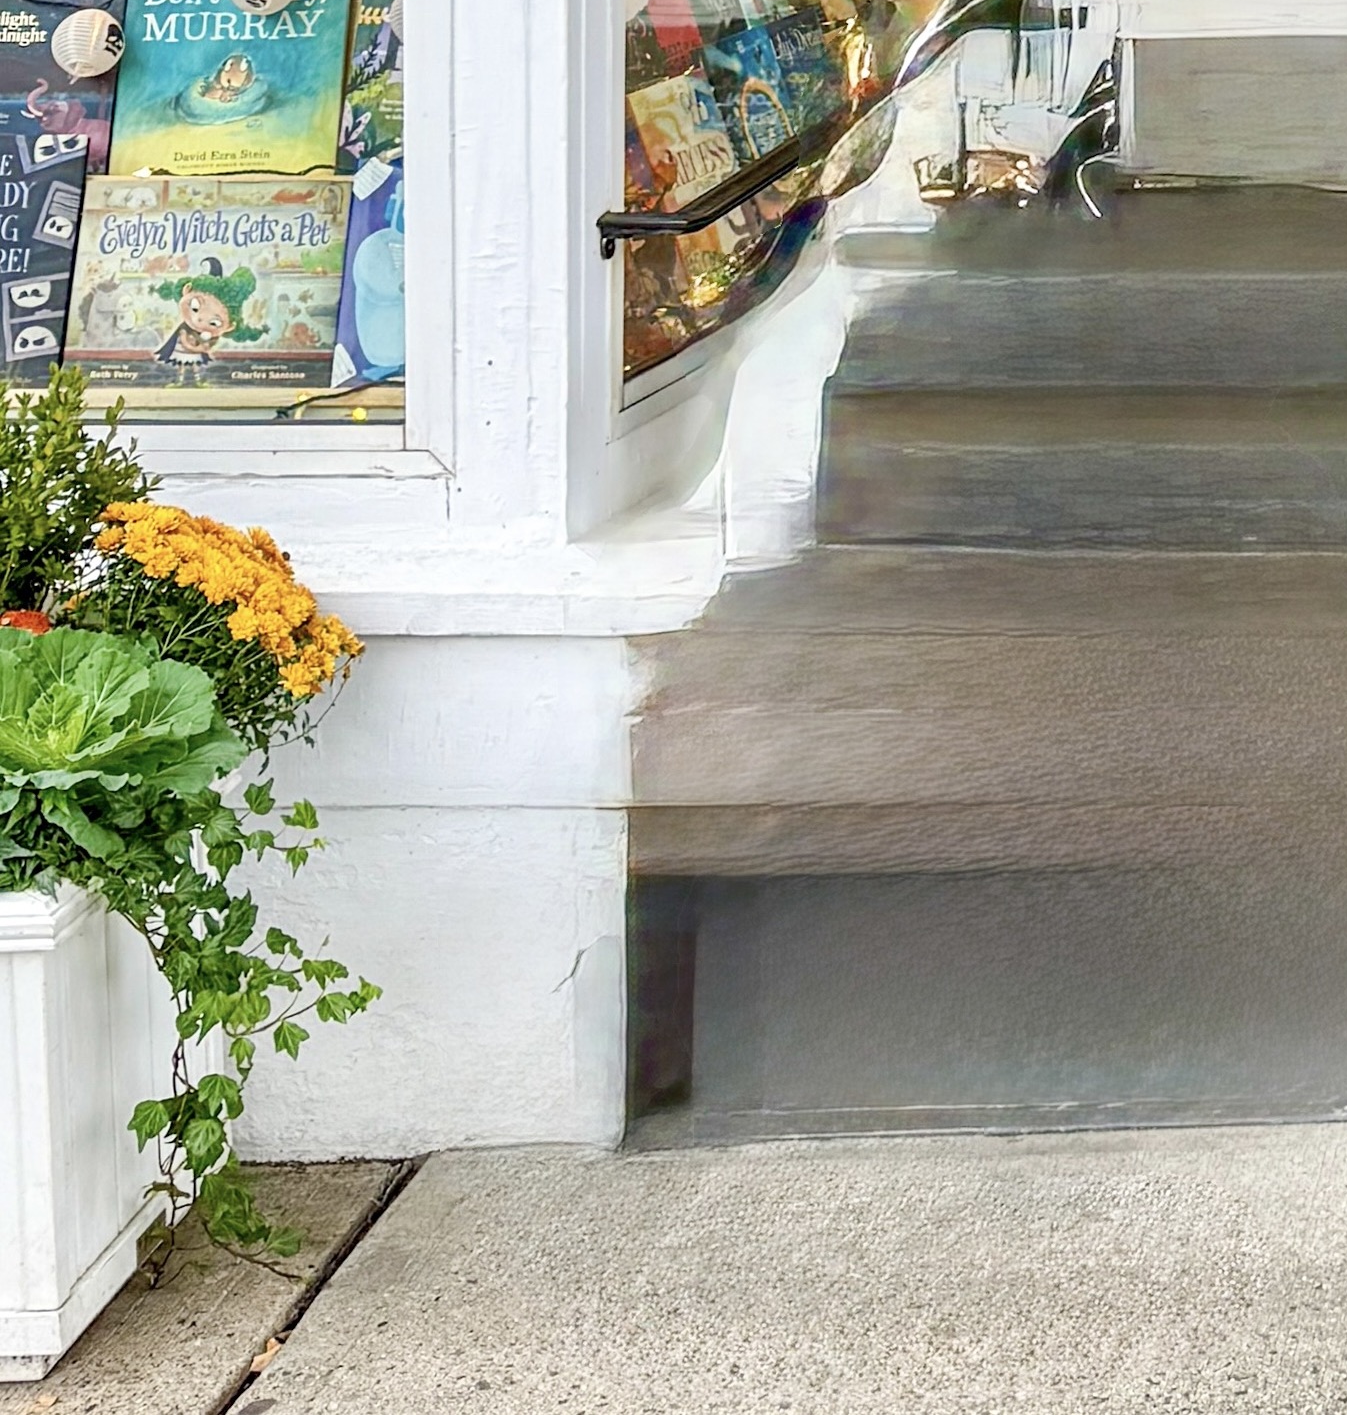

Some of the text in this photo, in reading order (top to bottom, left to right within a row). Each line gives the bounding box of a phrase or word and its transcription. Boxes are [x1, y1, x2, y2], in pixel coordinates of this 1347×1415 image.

[142, 9, 325, 43] MURRAY
[173, 149, 271, 163] David Ezra Stein
[99, 210, 333, 256] Evelyn Witch Gets a Pet
[230, 370, 268, 380] Charles
